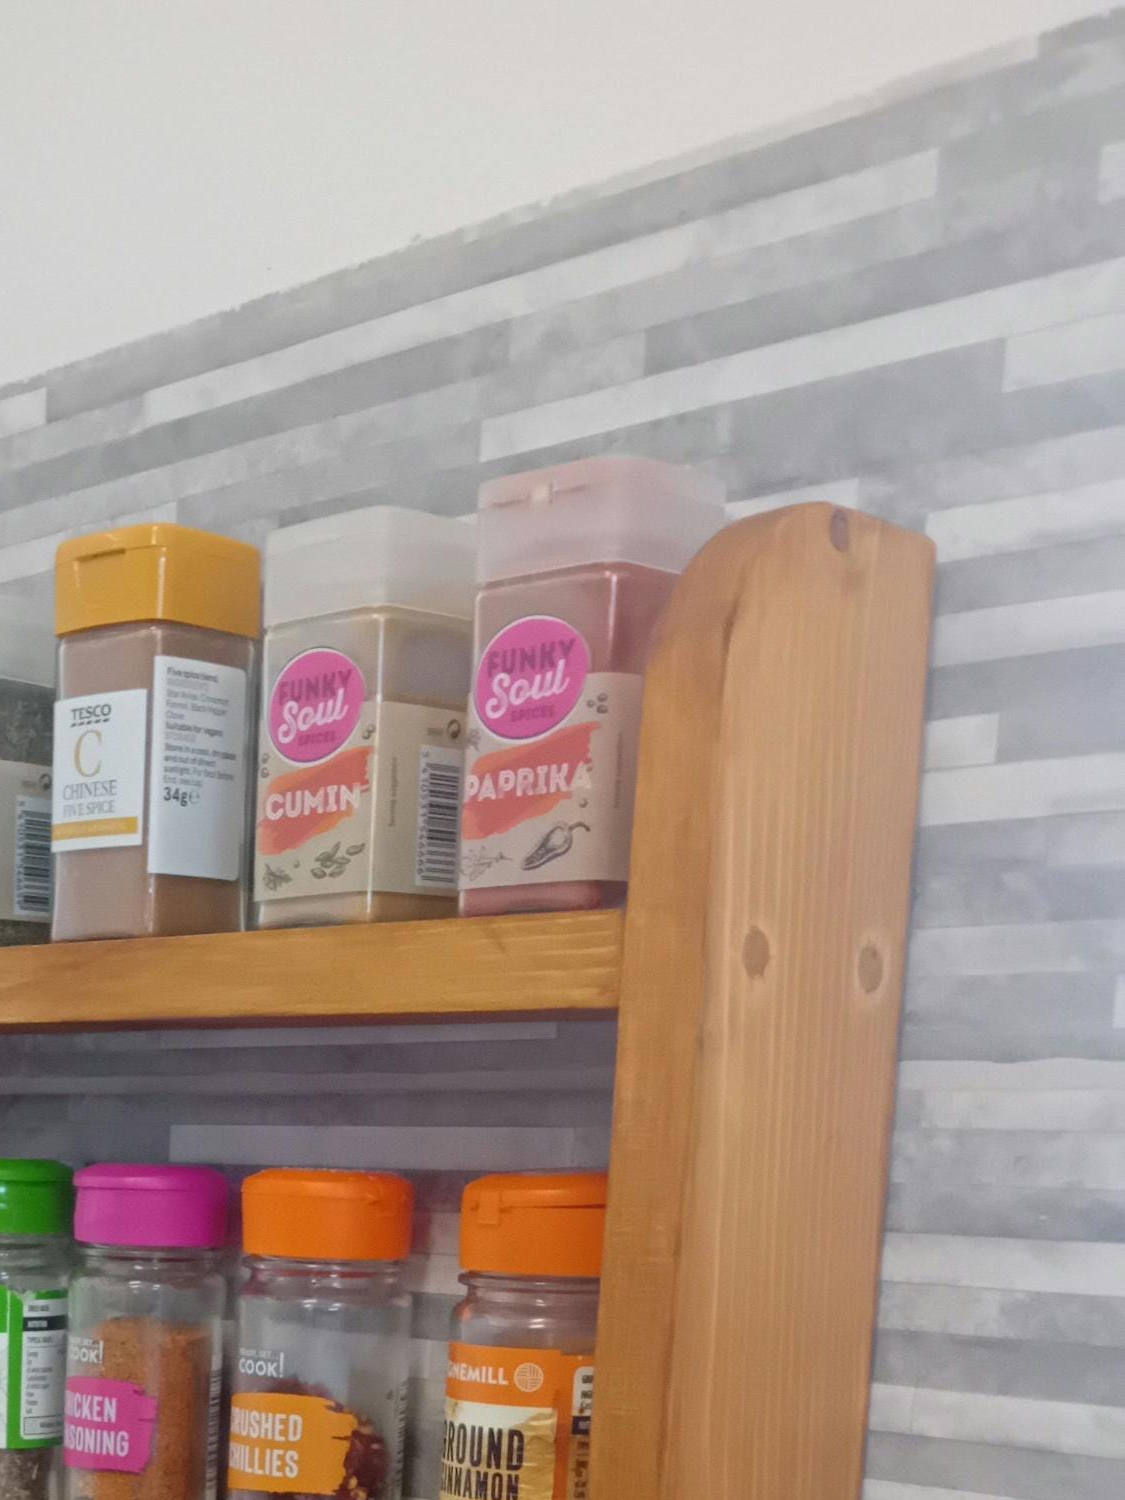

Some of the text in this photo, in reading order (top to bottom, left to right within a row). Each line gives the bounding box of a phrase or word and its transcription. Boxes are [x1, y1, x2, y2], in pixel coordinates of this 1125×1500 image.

[487, 638, 576, 678] FUNKY
[277, 669, 353, 704] FUNKY
[485, 658, 569, 719] Soul
[70, 704, 112, 722] TESCO
[278, 688, 348, 744] Soul
[74, 729, 103, 778] C
[62, 779, 118, 802] CHINESE
[464, 760, 592, 803] PAPRIKA
[85, 800, 116, 816] SPICE
[265, 783, 363, 821] CUMIN
[238, 1352, 285, 1378] COOK!
[230, 1405, 303, 1442] RUSHED
